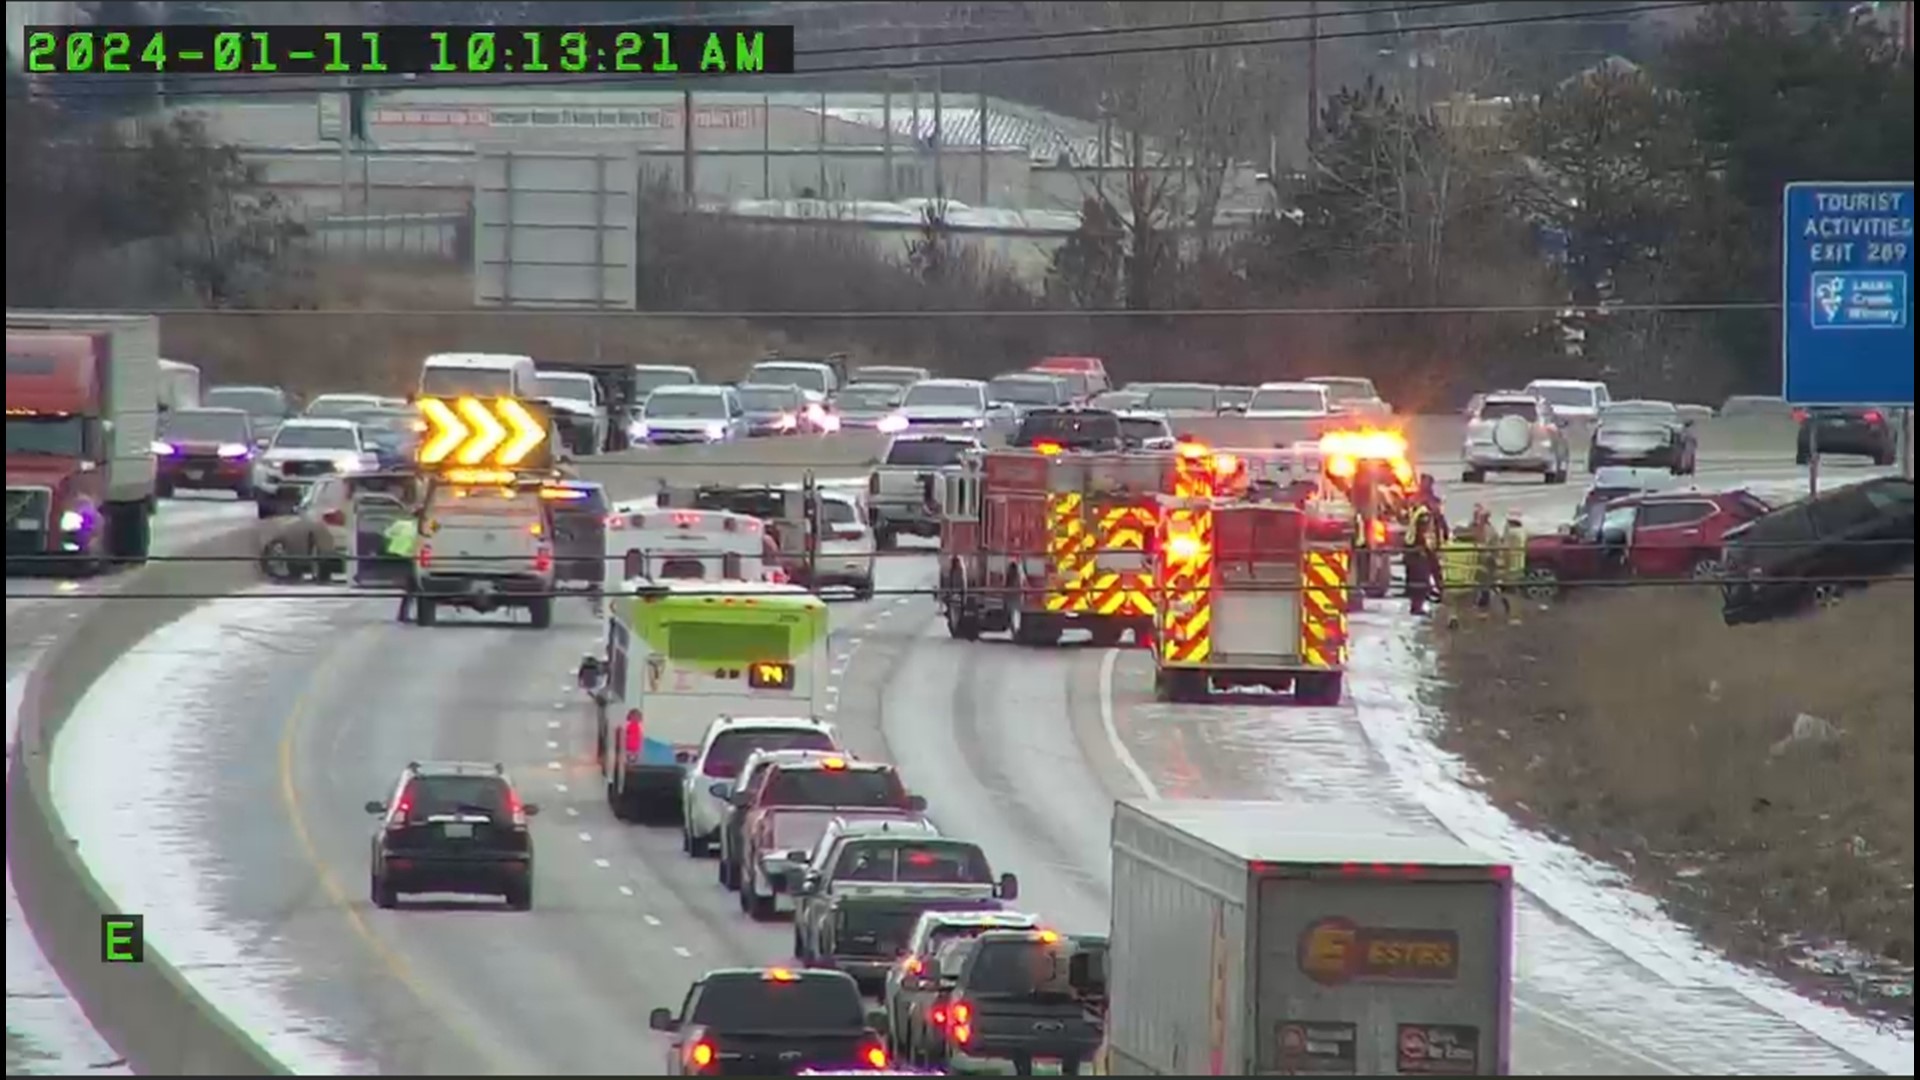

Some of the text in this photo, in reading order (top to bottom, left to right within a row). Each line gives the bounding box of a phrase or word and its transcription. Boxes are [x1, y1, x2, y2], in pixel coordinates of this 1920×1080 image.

[1816, 192, 1904, 212] TOURIST
[1803, 217, 1913, 238] ACTIVITIES
[1810, 242, 1907, 263] EXIT 289
[1366, 940, 1453, 966] ESTES
